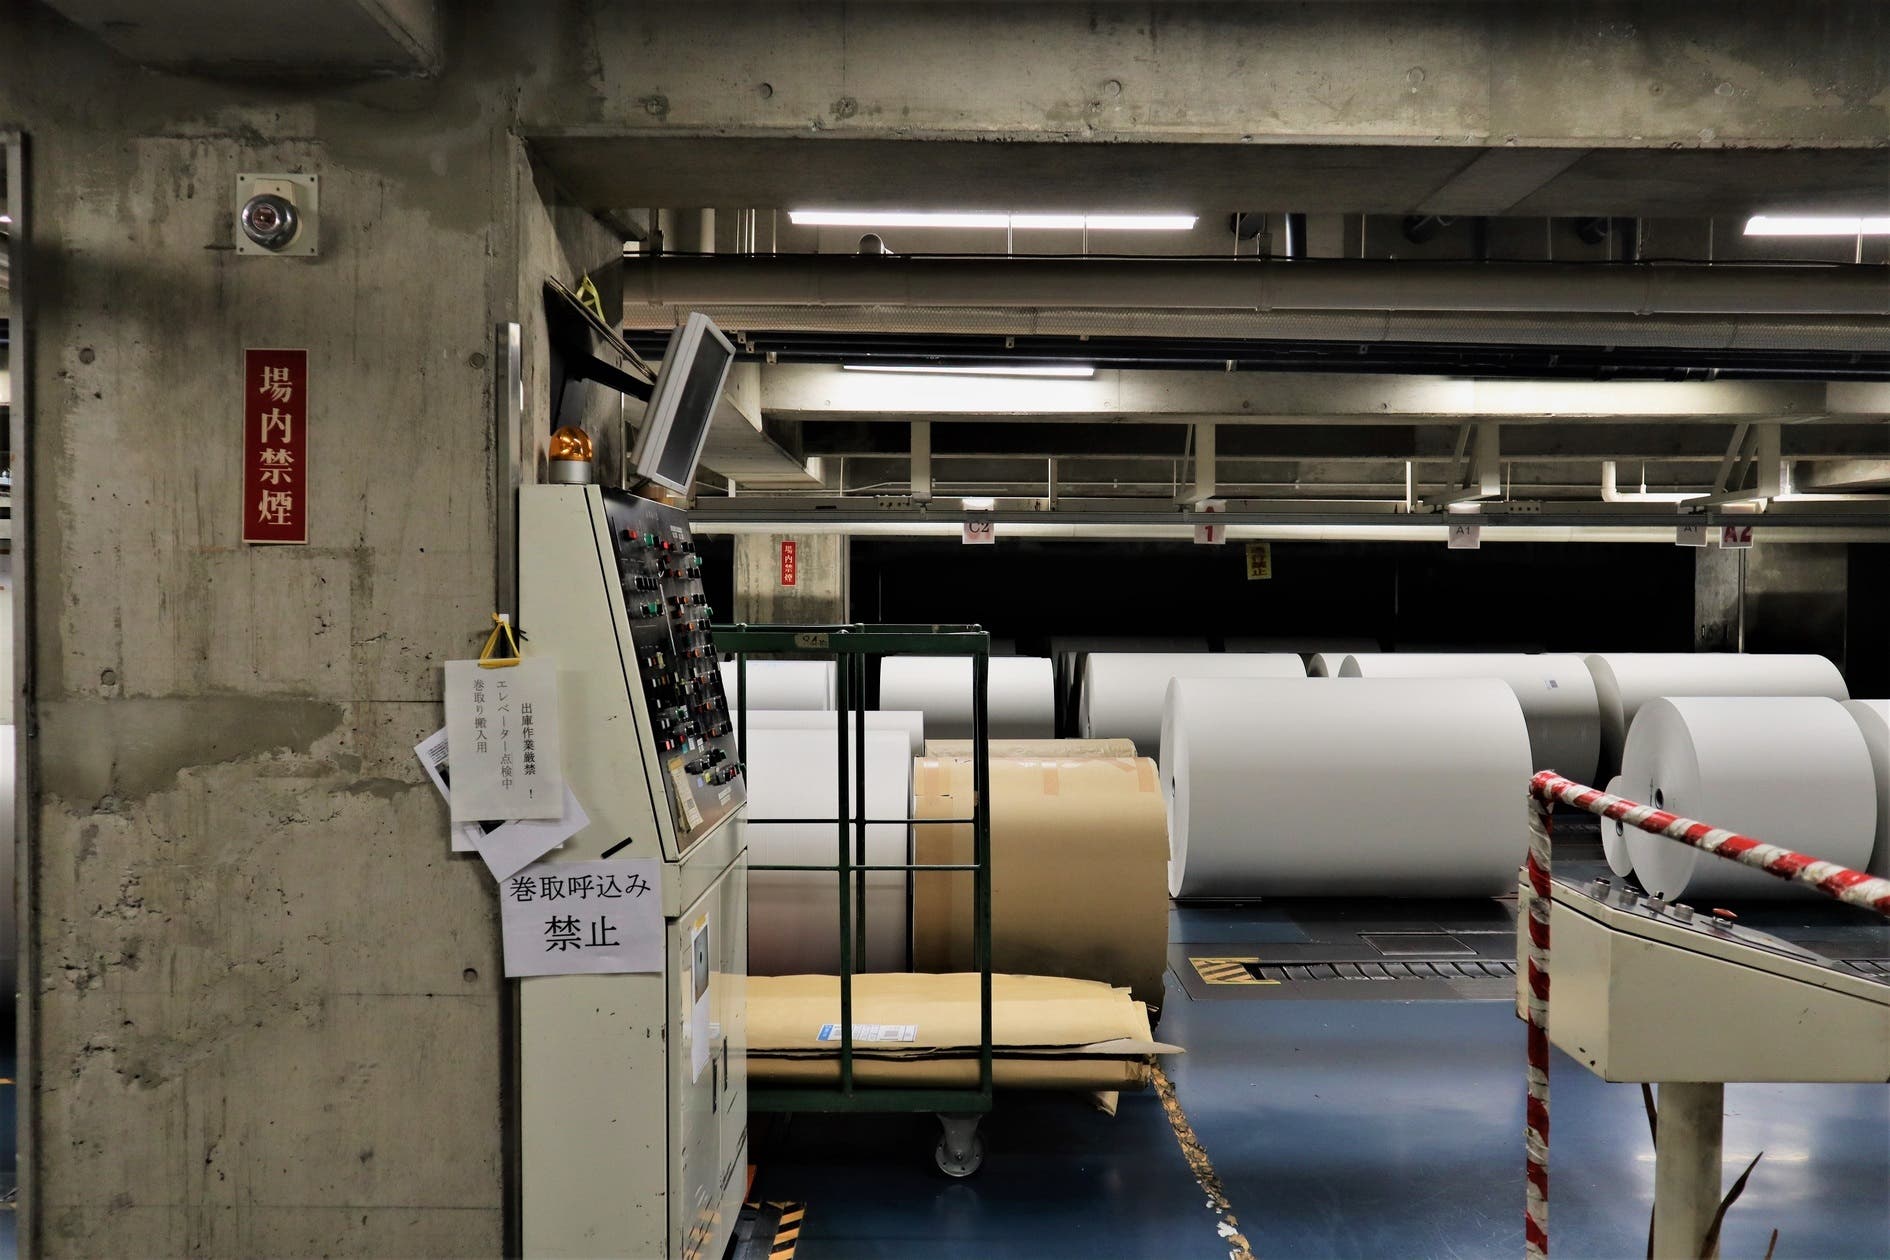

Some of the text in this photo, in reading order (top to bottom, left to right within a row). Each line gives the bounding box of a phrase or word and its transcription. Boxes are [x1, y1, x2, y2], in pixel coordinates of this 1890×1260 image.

[259, 366, 294, 525] 場内禁煙
[969, 520, 990, 533] C2
[1456, 526, 1470, 535] A1
[1724, 525, 1753, 543] A2
[473, 679, 487, 753] 巻取り搬入用
[496, 680, 512, 790] エレベーター点検中
[510, 874, 651, 902] 巻取呼込み
[544, 915, 620, 952] 禁止
